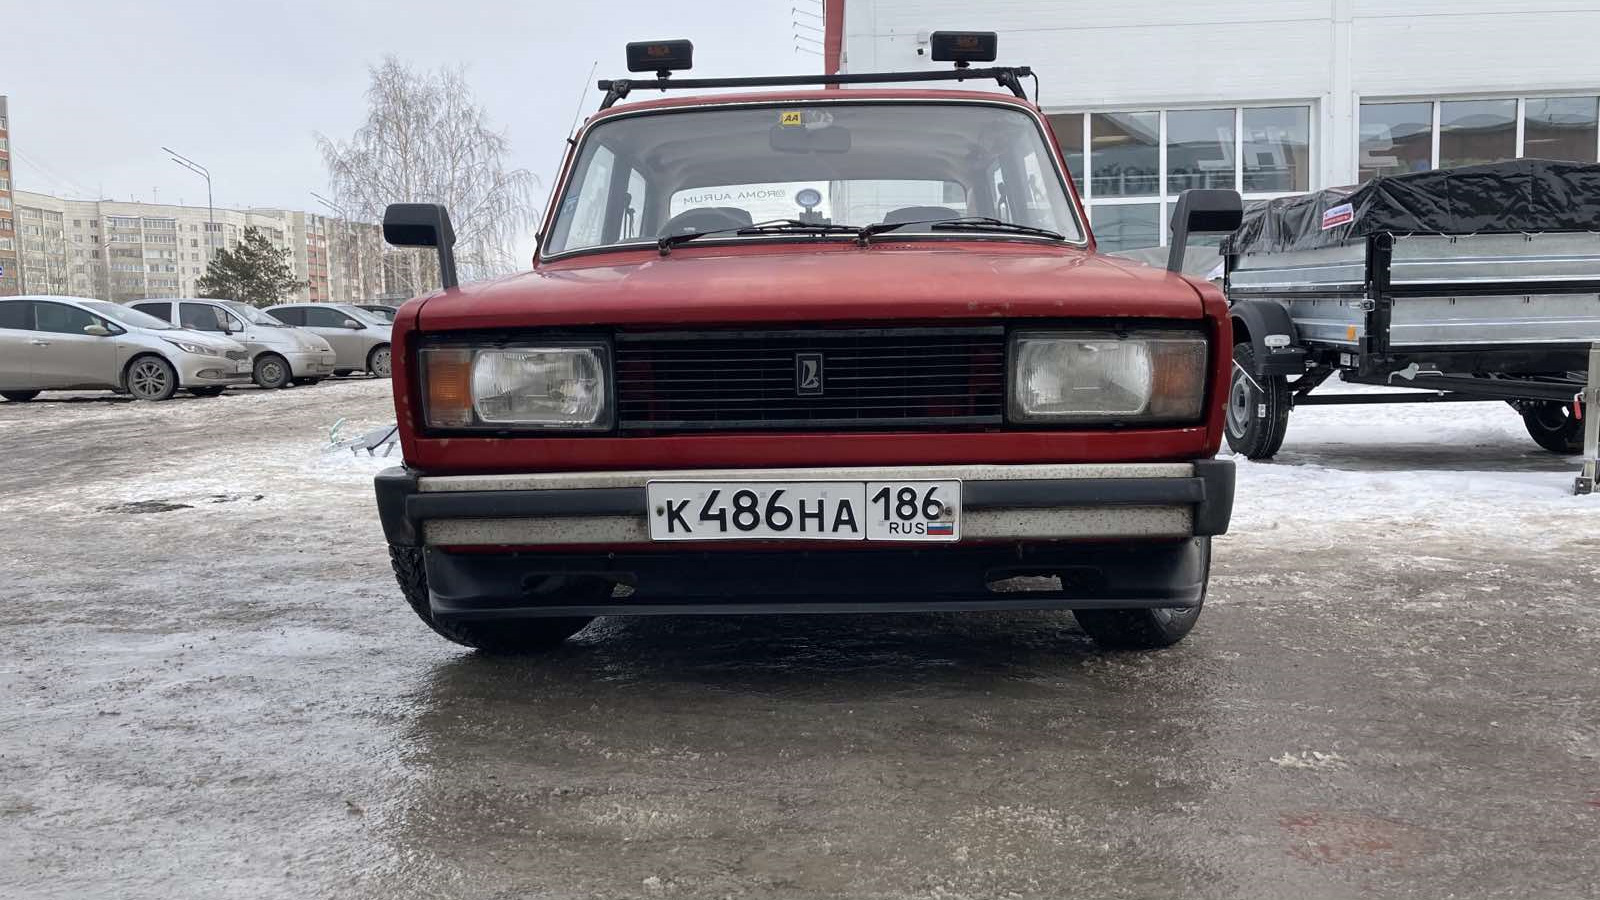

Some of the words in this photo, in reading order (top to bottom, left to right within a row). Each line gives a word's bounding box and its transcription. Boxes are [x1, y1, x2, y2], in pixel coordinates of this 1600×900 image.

[784, 114, 799, 122] AA
[871, 486, 945, 521] 186
[888, 521, 926, 535] RUS
